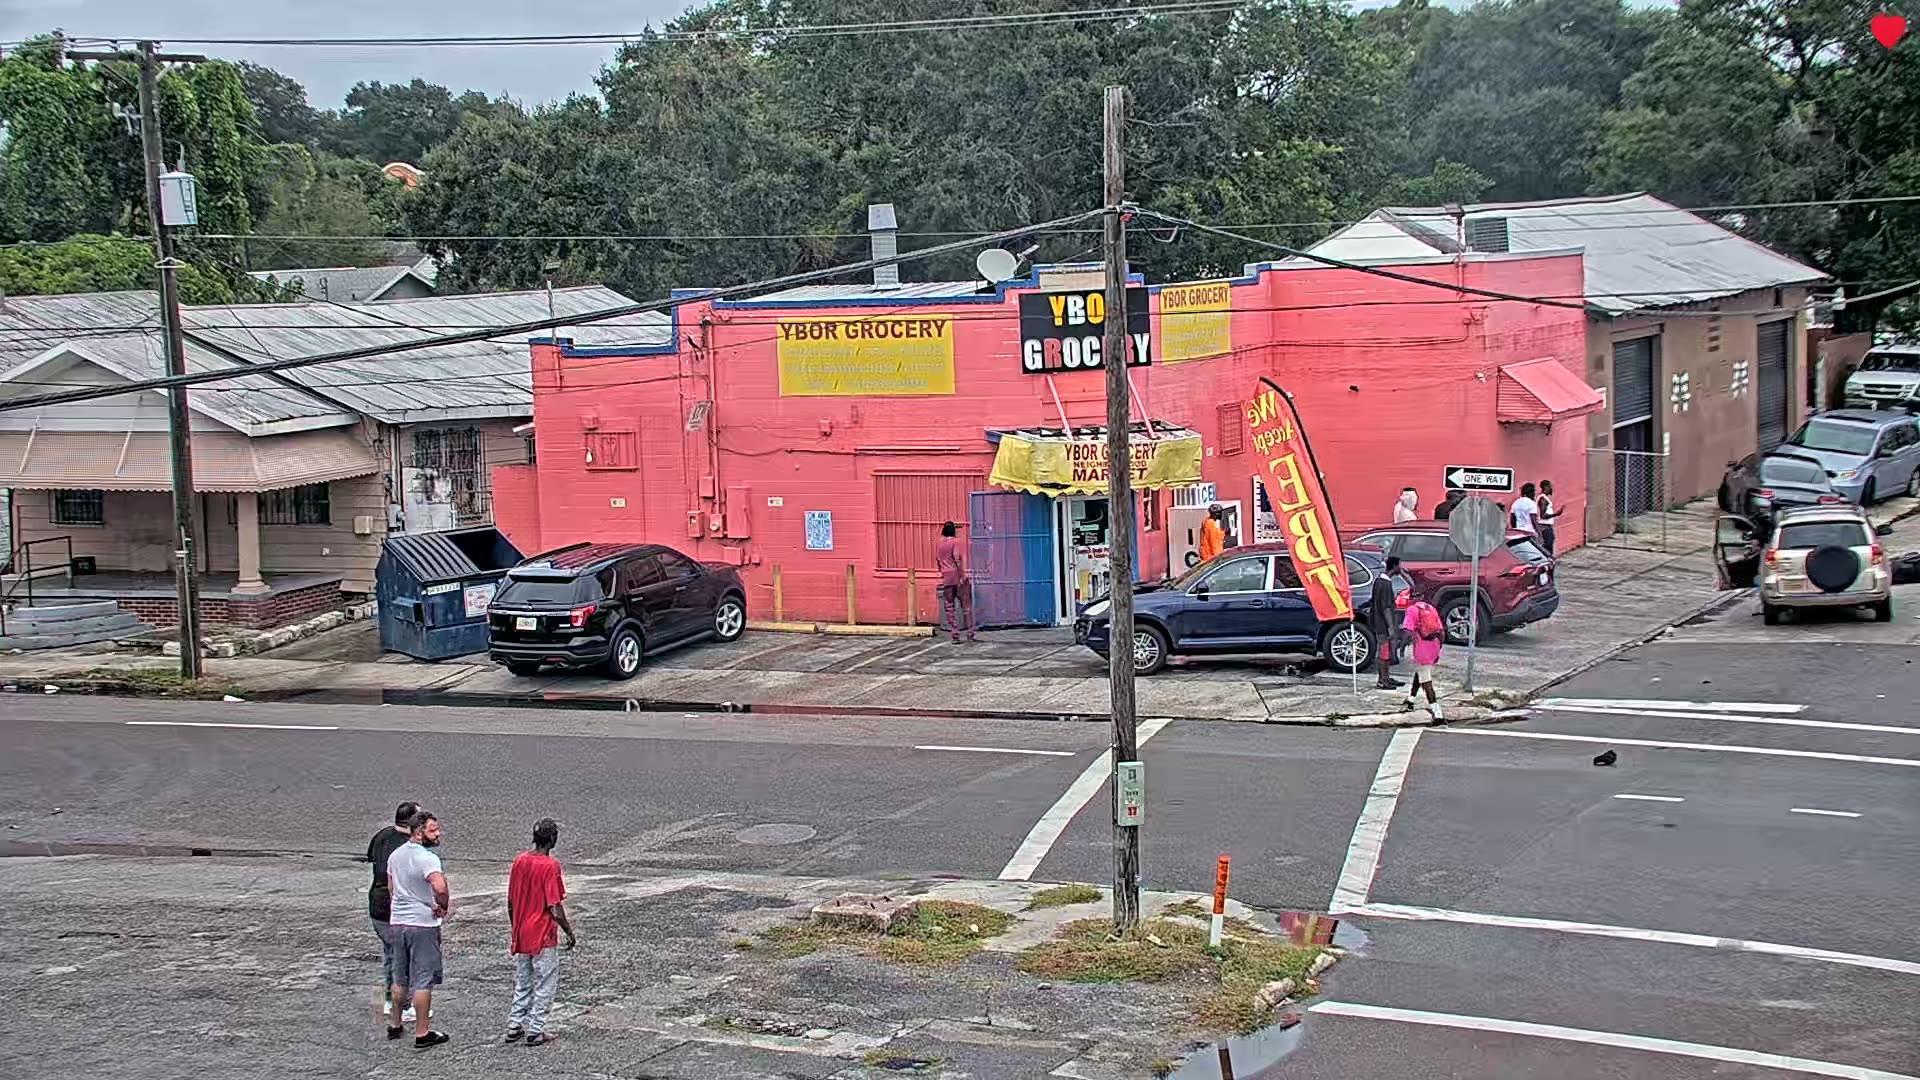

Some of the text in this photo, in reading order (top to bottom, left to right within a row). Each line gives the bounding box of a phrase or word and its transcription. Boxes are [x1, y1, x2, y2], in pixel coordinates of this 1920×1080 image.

[1162, 286, 1228, 309] YBOR GROCERY
[1049, 292, 1105, 326] YBO
[779, 320, 945, 341] YBOR GROCERY
[1065, 443, 1158, 461] YBOR GCERY
[1073, 468, 1147, 481] MARET
[1464, 474, 1505, 484] ONE WAY
